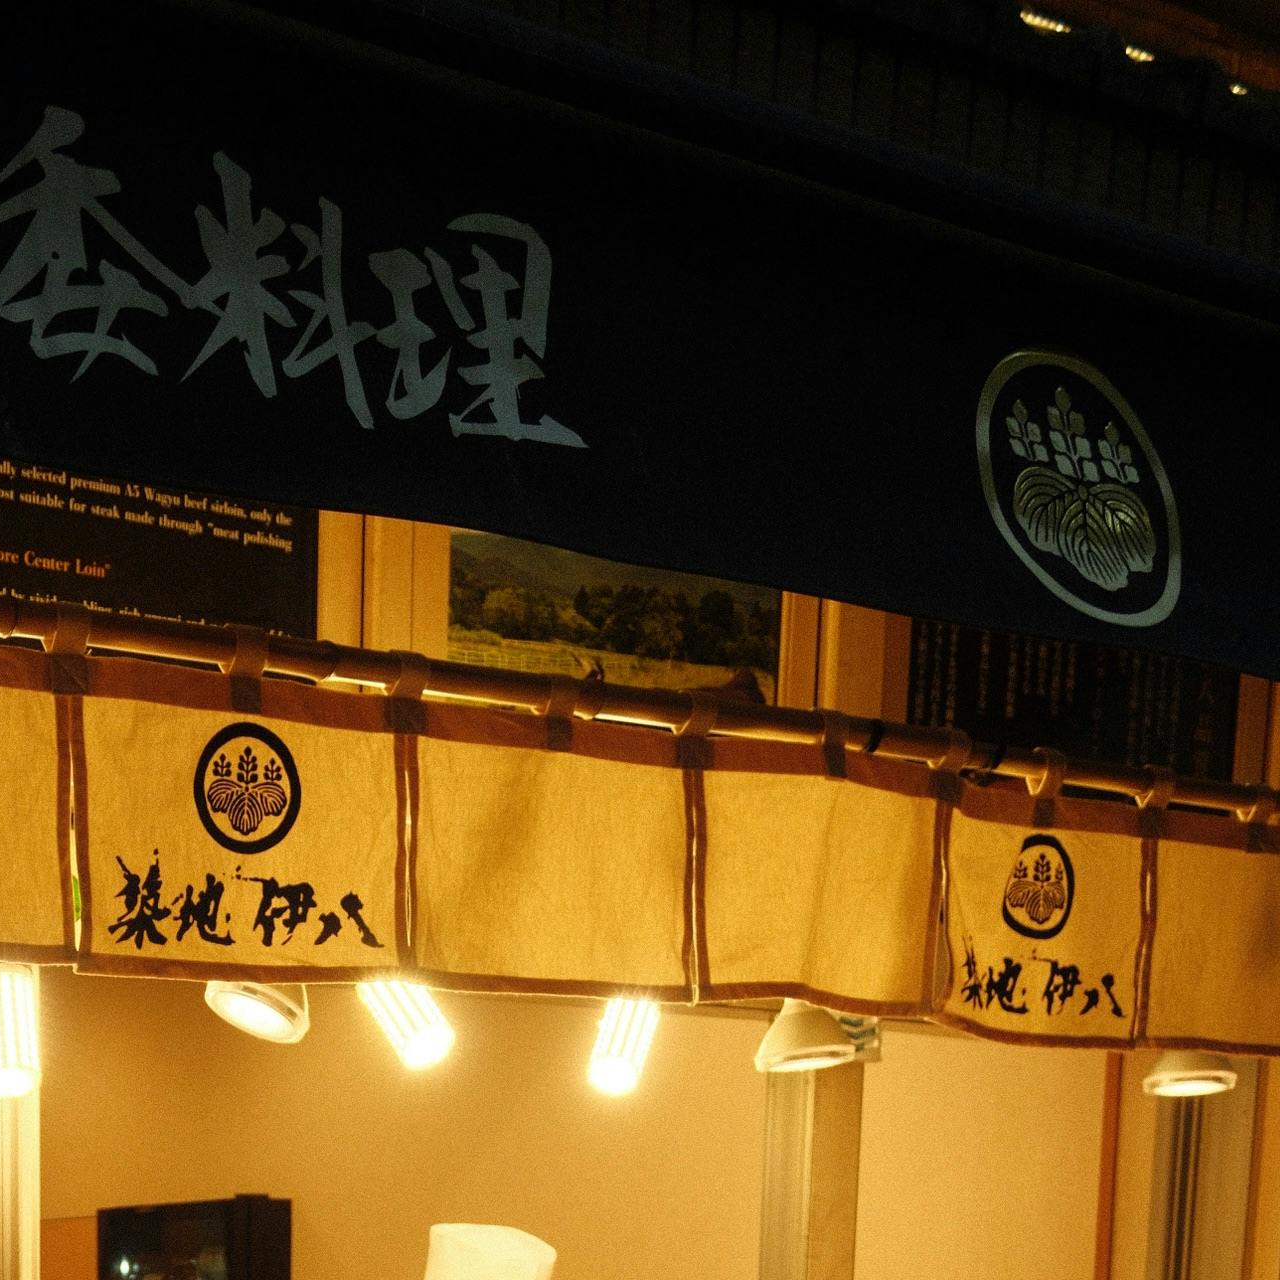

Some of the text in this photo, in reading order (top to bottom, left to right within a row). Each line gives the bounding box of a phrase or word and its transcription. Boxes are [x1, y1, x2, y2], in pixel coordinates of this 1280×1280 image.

[20, 490, 64, 509] suitable
[69, 497, 86, 512] for
[91, 504, 120, 519] steak
[125, 511, 155, 525] made
[159, 514, 202, 535] through
[244, 531, 293, 553] polishing
[21, 466, 66, 485] selected
[70, 476, 120, 496] premium
[125, 483, 140, 498] A5
[144, 486, 181, 507] Wagyu
[184, 494, 208, 510] beef
[210, 500, 247, 518] sirloin,
[250, 508, 272, 526] only
[276, 511, 293, 526] the
[24, 550, 69, 572] Center
[76, 559, 112, 578] Loin"
